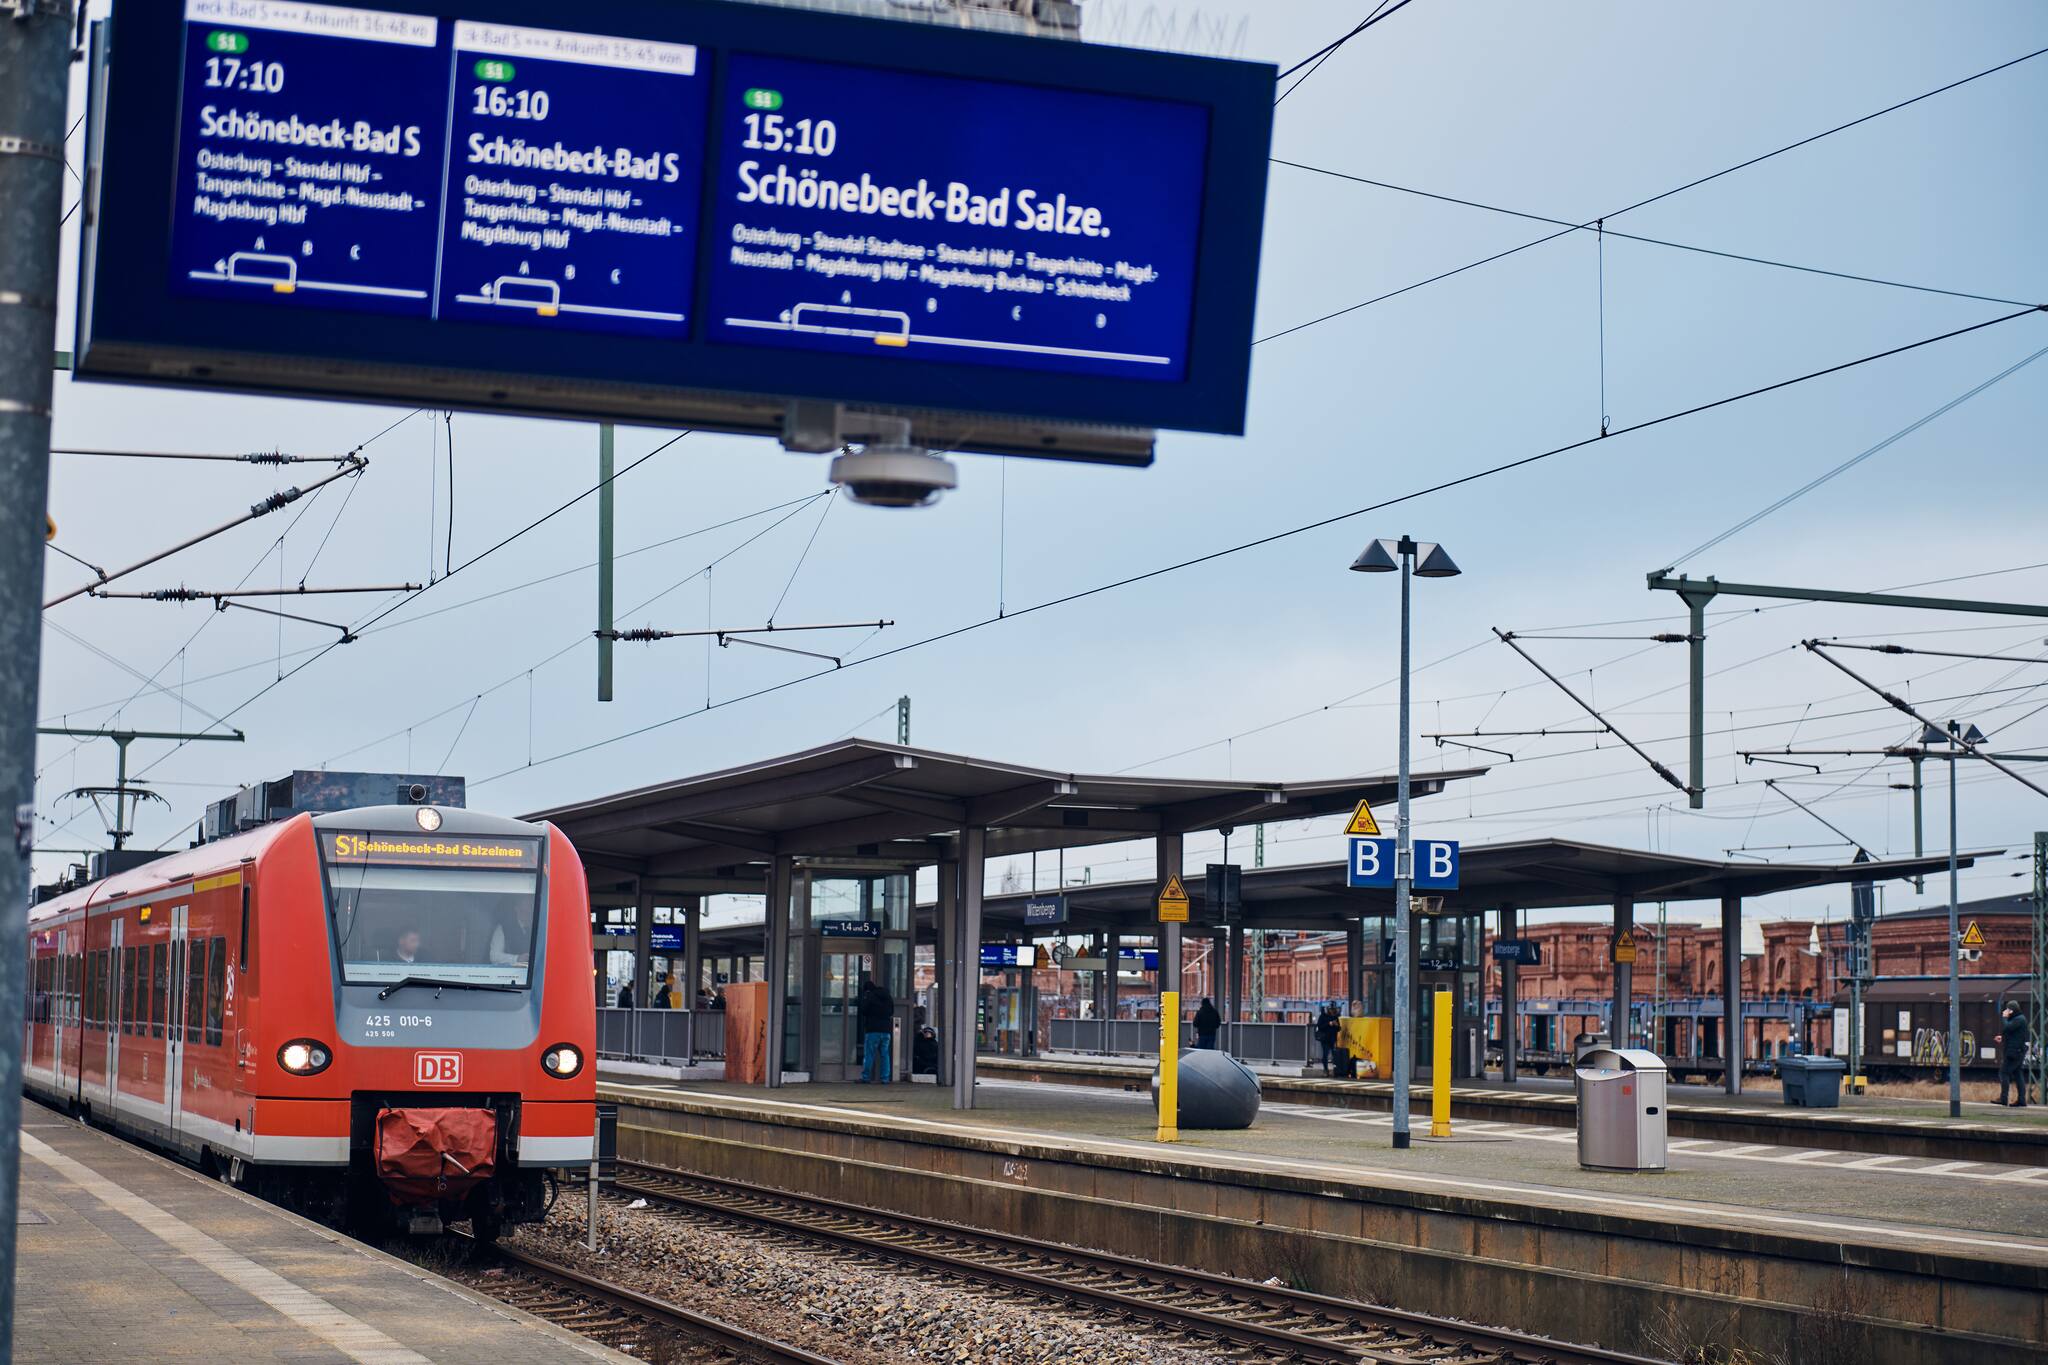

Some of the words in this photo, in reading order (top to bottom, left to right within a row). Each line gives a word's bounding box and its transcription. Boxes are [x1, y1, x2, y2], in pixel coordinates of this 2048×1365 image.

[217, 33, 237, 50] S1
[204, 57, 285, 93] 17:10
[485, 62, 504, 79] S1
[472, 85, 549, 121] 16:10
[200, 105, 401, 154] Schönebeck-Bad
[403, 126, 421, 156] S
[742, 113, 836, 157] 15:10
[197, 148, 272, 178] Osterburg
[285, 157, 342, 181] Stendal
[342, 164, 371, 183] Hbf
[467, 132, 660, 180] Schönebeck-Bad
[663, 153, 680, 183] S
[197, 172, 286, 199] Tangerhütte
[299, 181, 413, 211] Magd.-Neustadt
[464, 174, 536, 204] Osterburg
[549, 183, 603, 207] Stendal
[604, 189, 632, 209] Hbf
[737, 160, 1010, 228] Schönebeck-Bad
[1014, 189, 1111, 238] Salze.
[194, 196, 277, 226] Magdeburg
[278, 203, 308, 224] Hbf
[464, 198, 550, 224] Tangerhütte
[562, 208, 672, 237] Magd.-Neustadt
[254, 236, 265, 250] A
[302, 240, 313, 256] B
[350, 244, 361, 261] C
[461, 221, 542, 251] Magdeburg
[543, 230, 570, 250] Hbf
[732, 223, 801, 252] Osterburg
[519, 260, 530, 275] A
[611, 268, 621, 285] C
[335, 835, 358, 856] S1
[358, 839, 459, 856] Schönebeck-Bad
[1356, 840, 1380, 876] B
[1429, 842, 1453, 878] B
[1026, 902, 1056, 919] Wittenberge
[863, 922, 870, 932] 5
[365, 1030, 379, 1038] 425
[366, 1015, 391, 1027] 425
[399, 1015, 432, 1027] 010-6
[418, 1055, 459, 1082] DB
